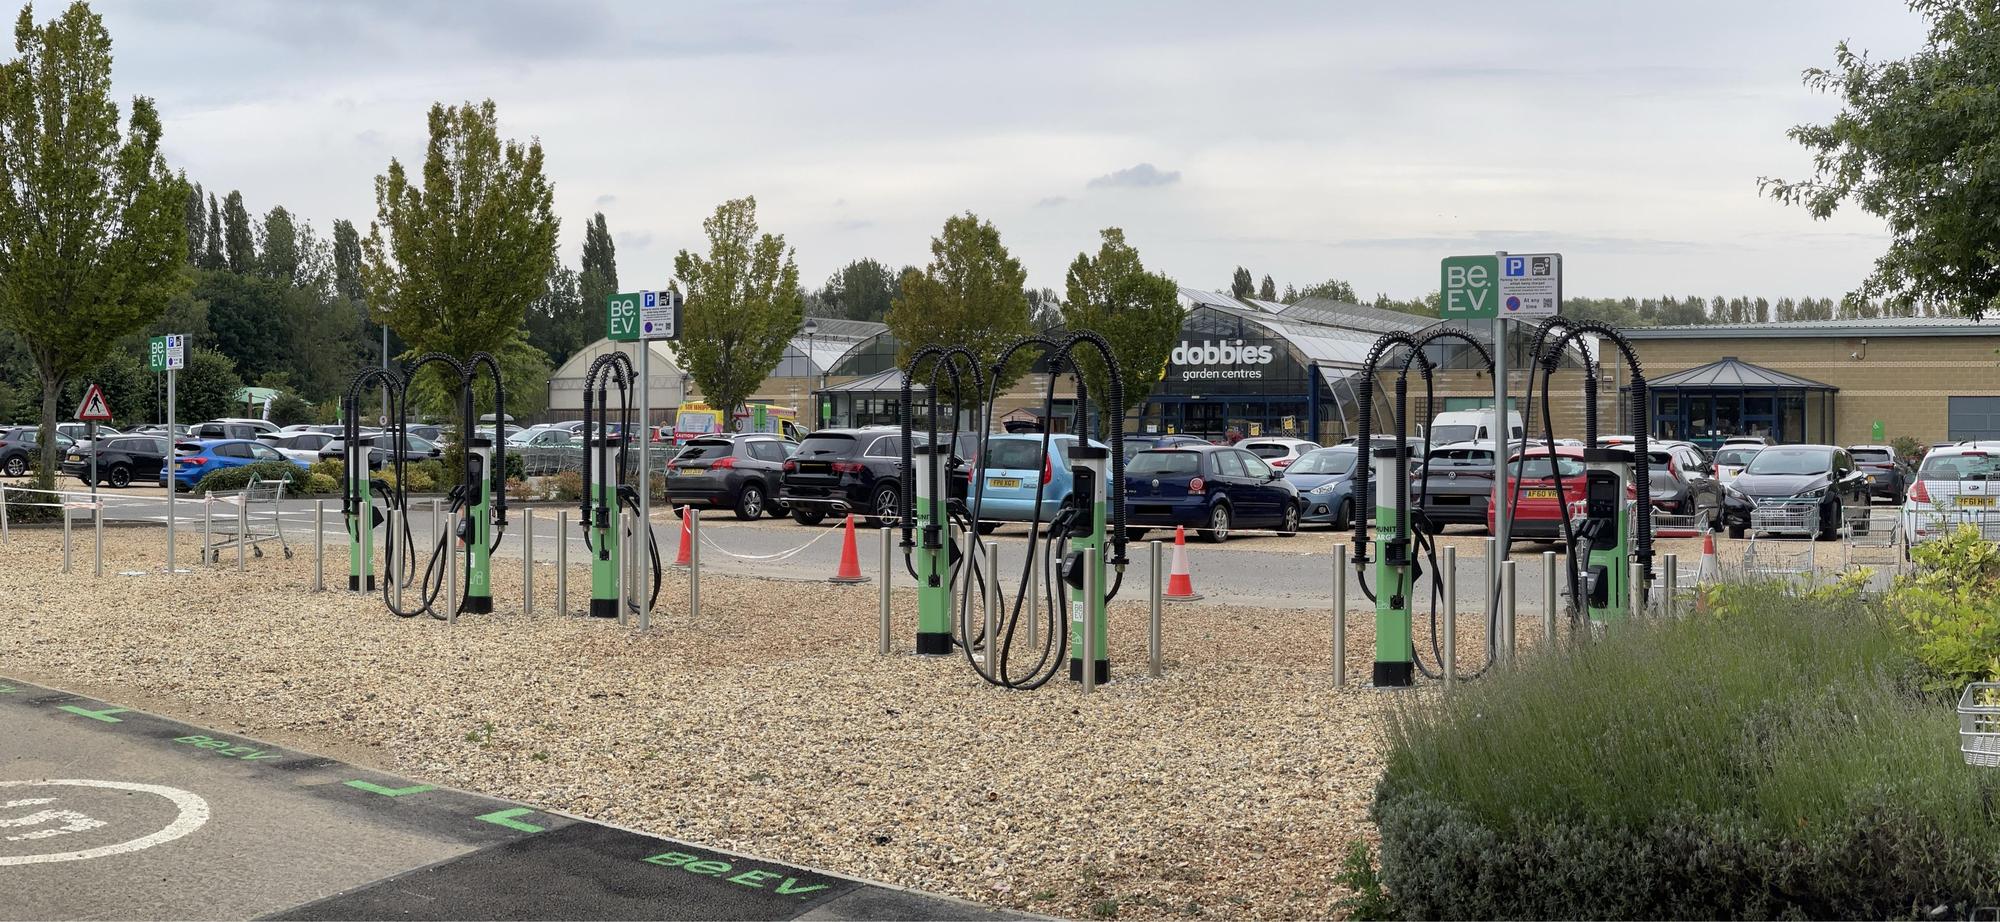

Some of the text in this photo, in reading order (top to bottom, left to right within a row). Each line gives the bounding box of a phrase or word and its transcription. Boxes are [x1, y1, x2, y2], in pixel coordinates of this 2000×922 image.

[1171, 339, 1273, 365] dobbies
[1182, 368, 1262, 381] garden centres
[1527, 490, 1546, 498] AF60
